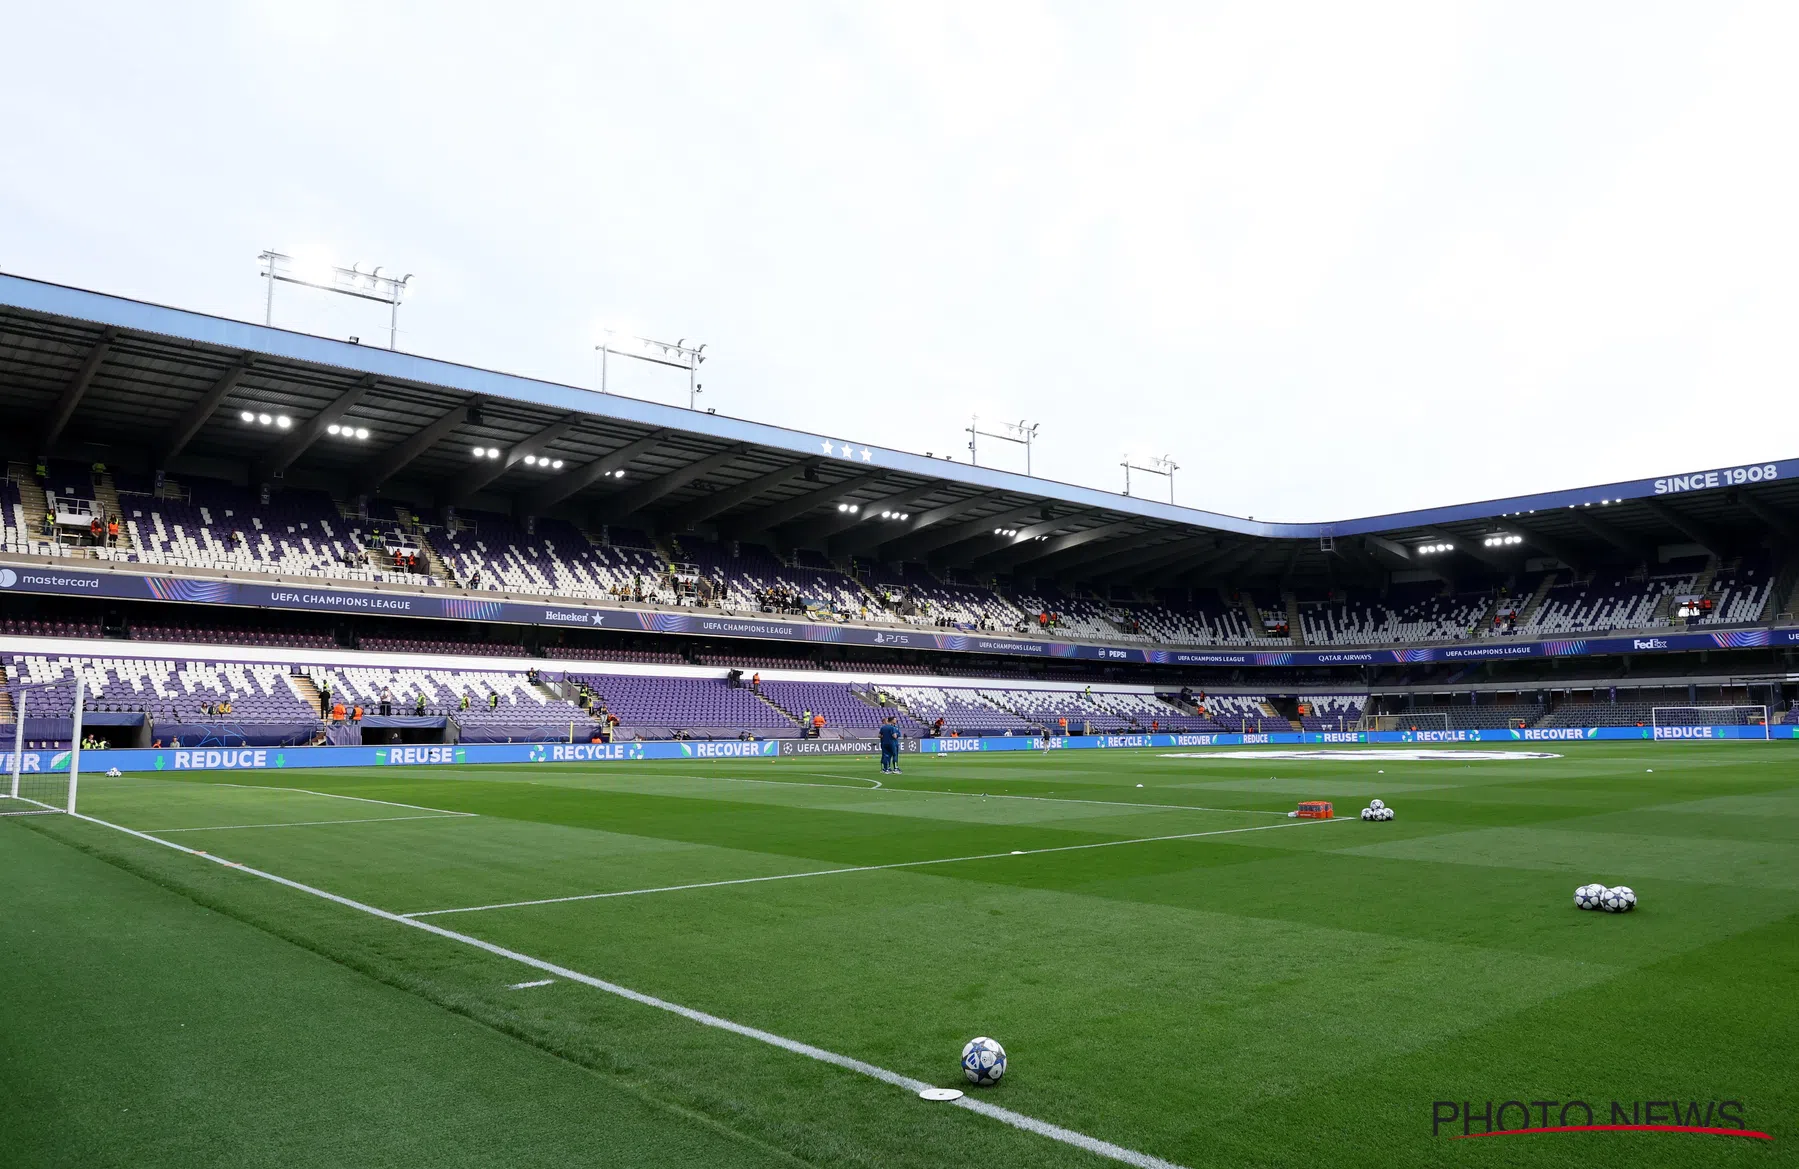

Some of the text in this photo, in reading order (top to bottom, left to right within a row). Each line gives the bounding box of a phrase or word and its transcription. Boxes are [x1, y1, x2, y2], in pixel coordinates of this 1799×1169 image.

[1654, 464, 1778, 494] SINCE 1908
[22, 575, 99, 588] mastercard
[271, 592, 411, 610] UEFA CHAMPIONS LEAGUE
[545, 610, 588, 622] Heineken
[703, 622, 793, 634] UEFA CHAMPIONS LEAGUE
[886, 634, 908, 643] PS5
[1634, 639, 1668, 649] FedEx
[993, 642, 1022, 650] CHAMPIONS
[1324, 733, 1358, 742] REUSE
[1416, 731, 1466, 740] RECYCLE
[1524, 729, 1584, 740] RECOVER
[1655, 727, 1712, 738] REDUCE
[1108, 736, 1142, 746] RECYCLE
[1178, 736, 1210, 745] RECOVER
[1243, 734, 1268, 744] REDUCE
[698, 743, 759, 756] RECOVER
[798, 744, 820, 752] UEFA
[822, 742, 872, 752] CHAMPIONS
[940, 740, 980, 750] REDUCE
[390, 748, 452, 764] REUSE
[553, 745, 624, 760] RECYCLE
[174, 750, 267, 768] REDUCE
